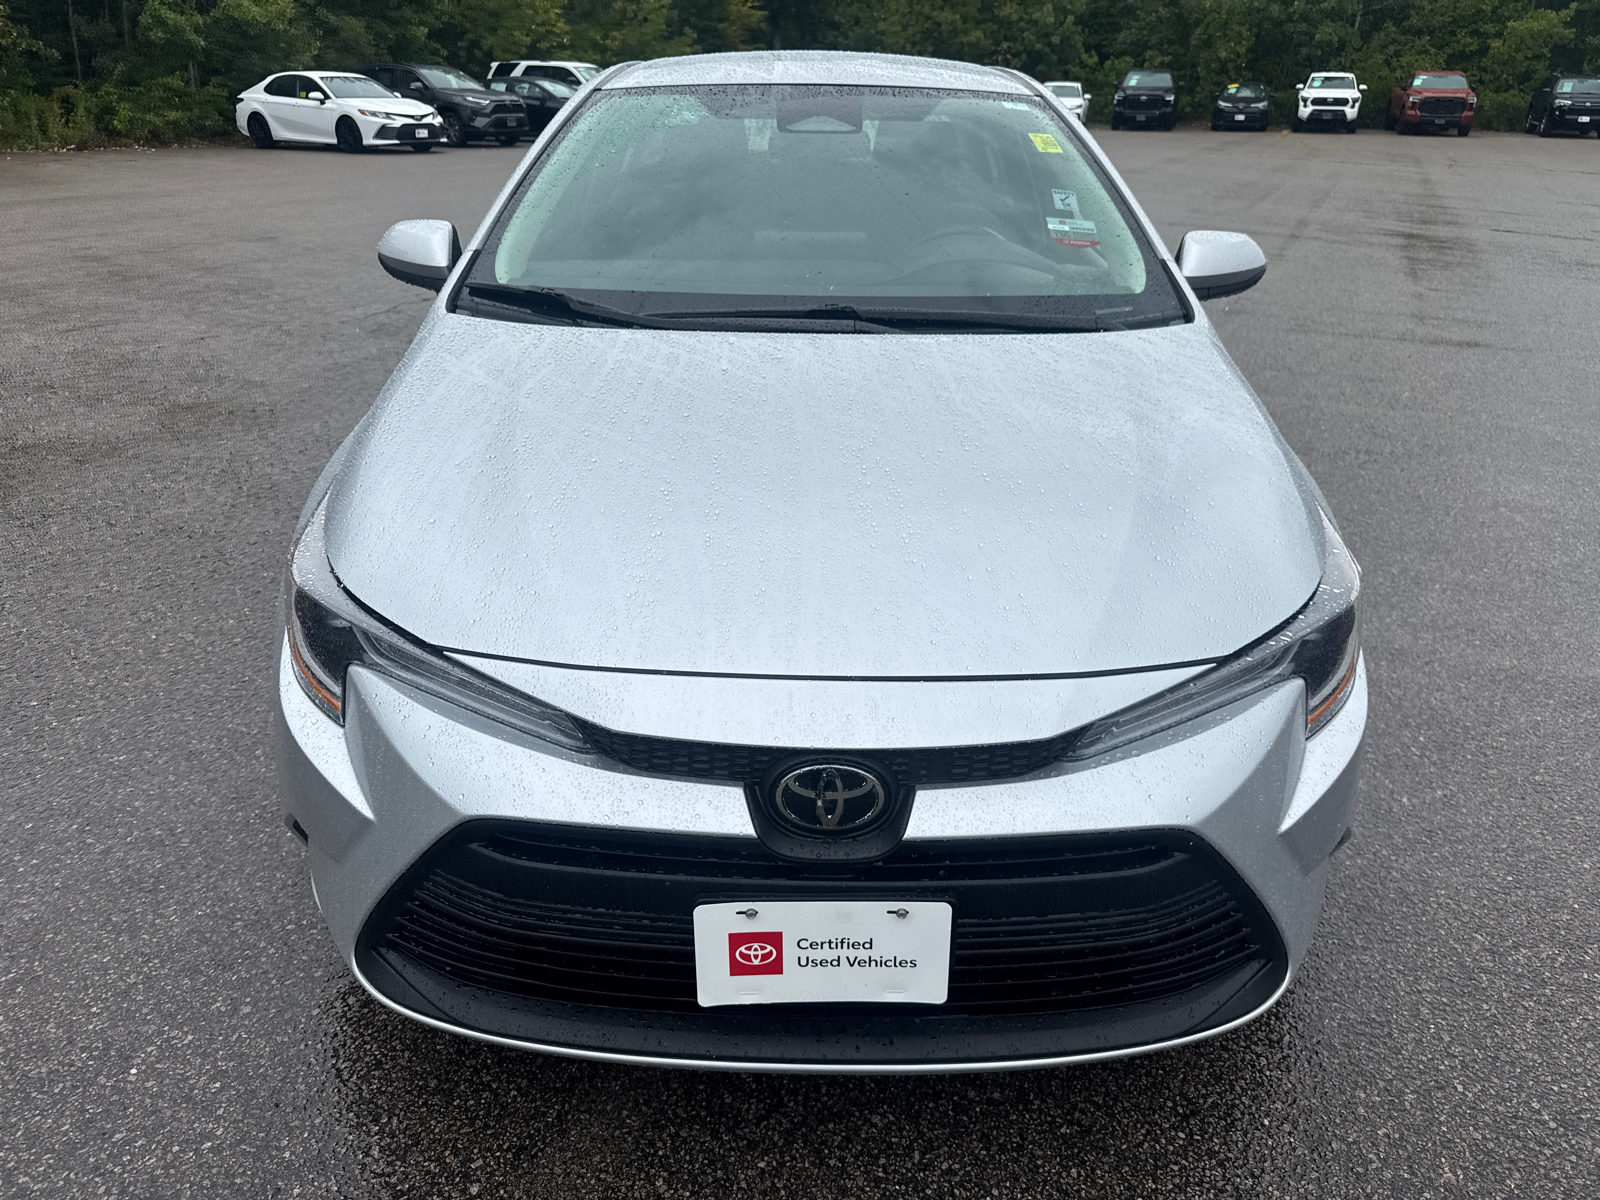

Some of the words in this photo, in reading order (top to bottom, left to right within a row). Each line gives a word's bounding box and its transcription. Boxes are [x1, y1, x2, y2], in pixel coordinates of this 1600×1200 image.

[796, 937, 874, 951] Certified
[796, 955, 841, 968] Used
[845, 955, 918, 969] Vehicles
